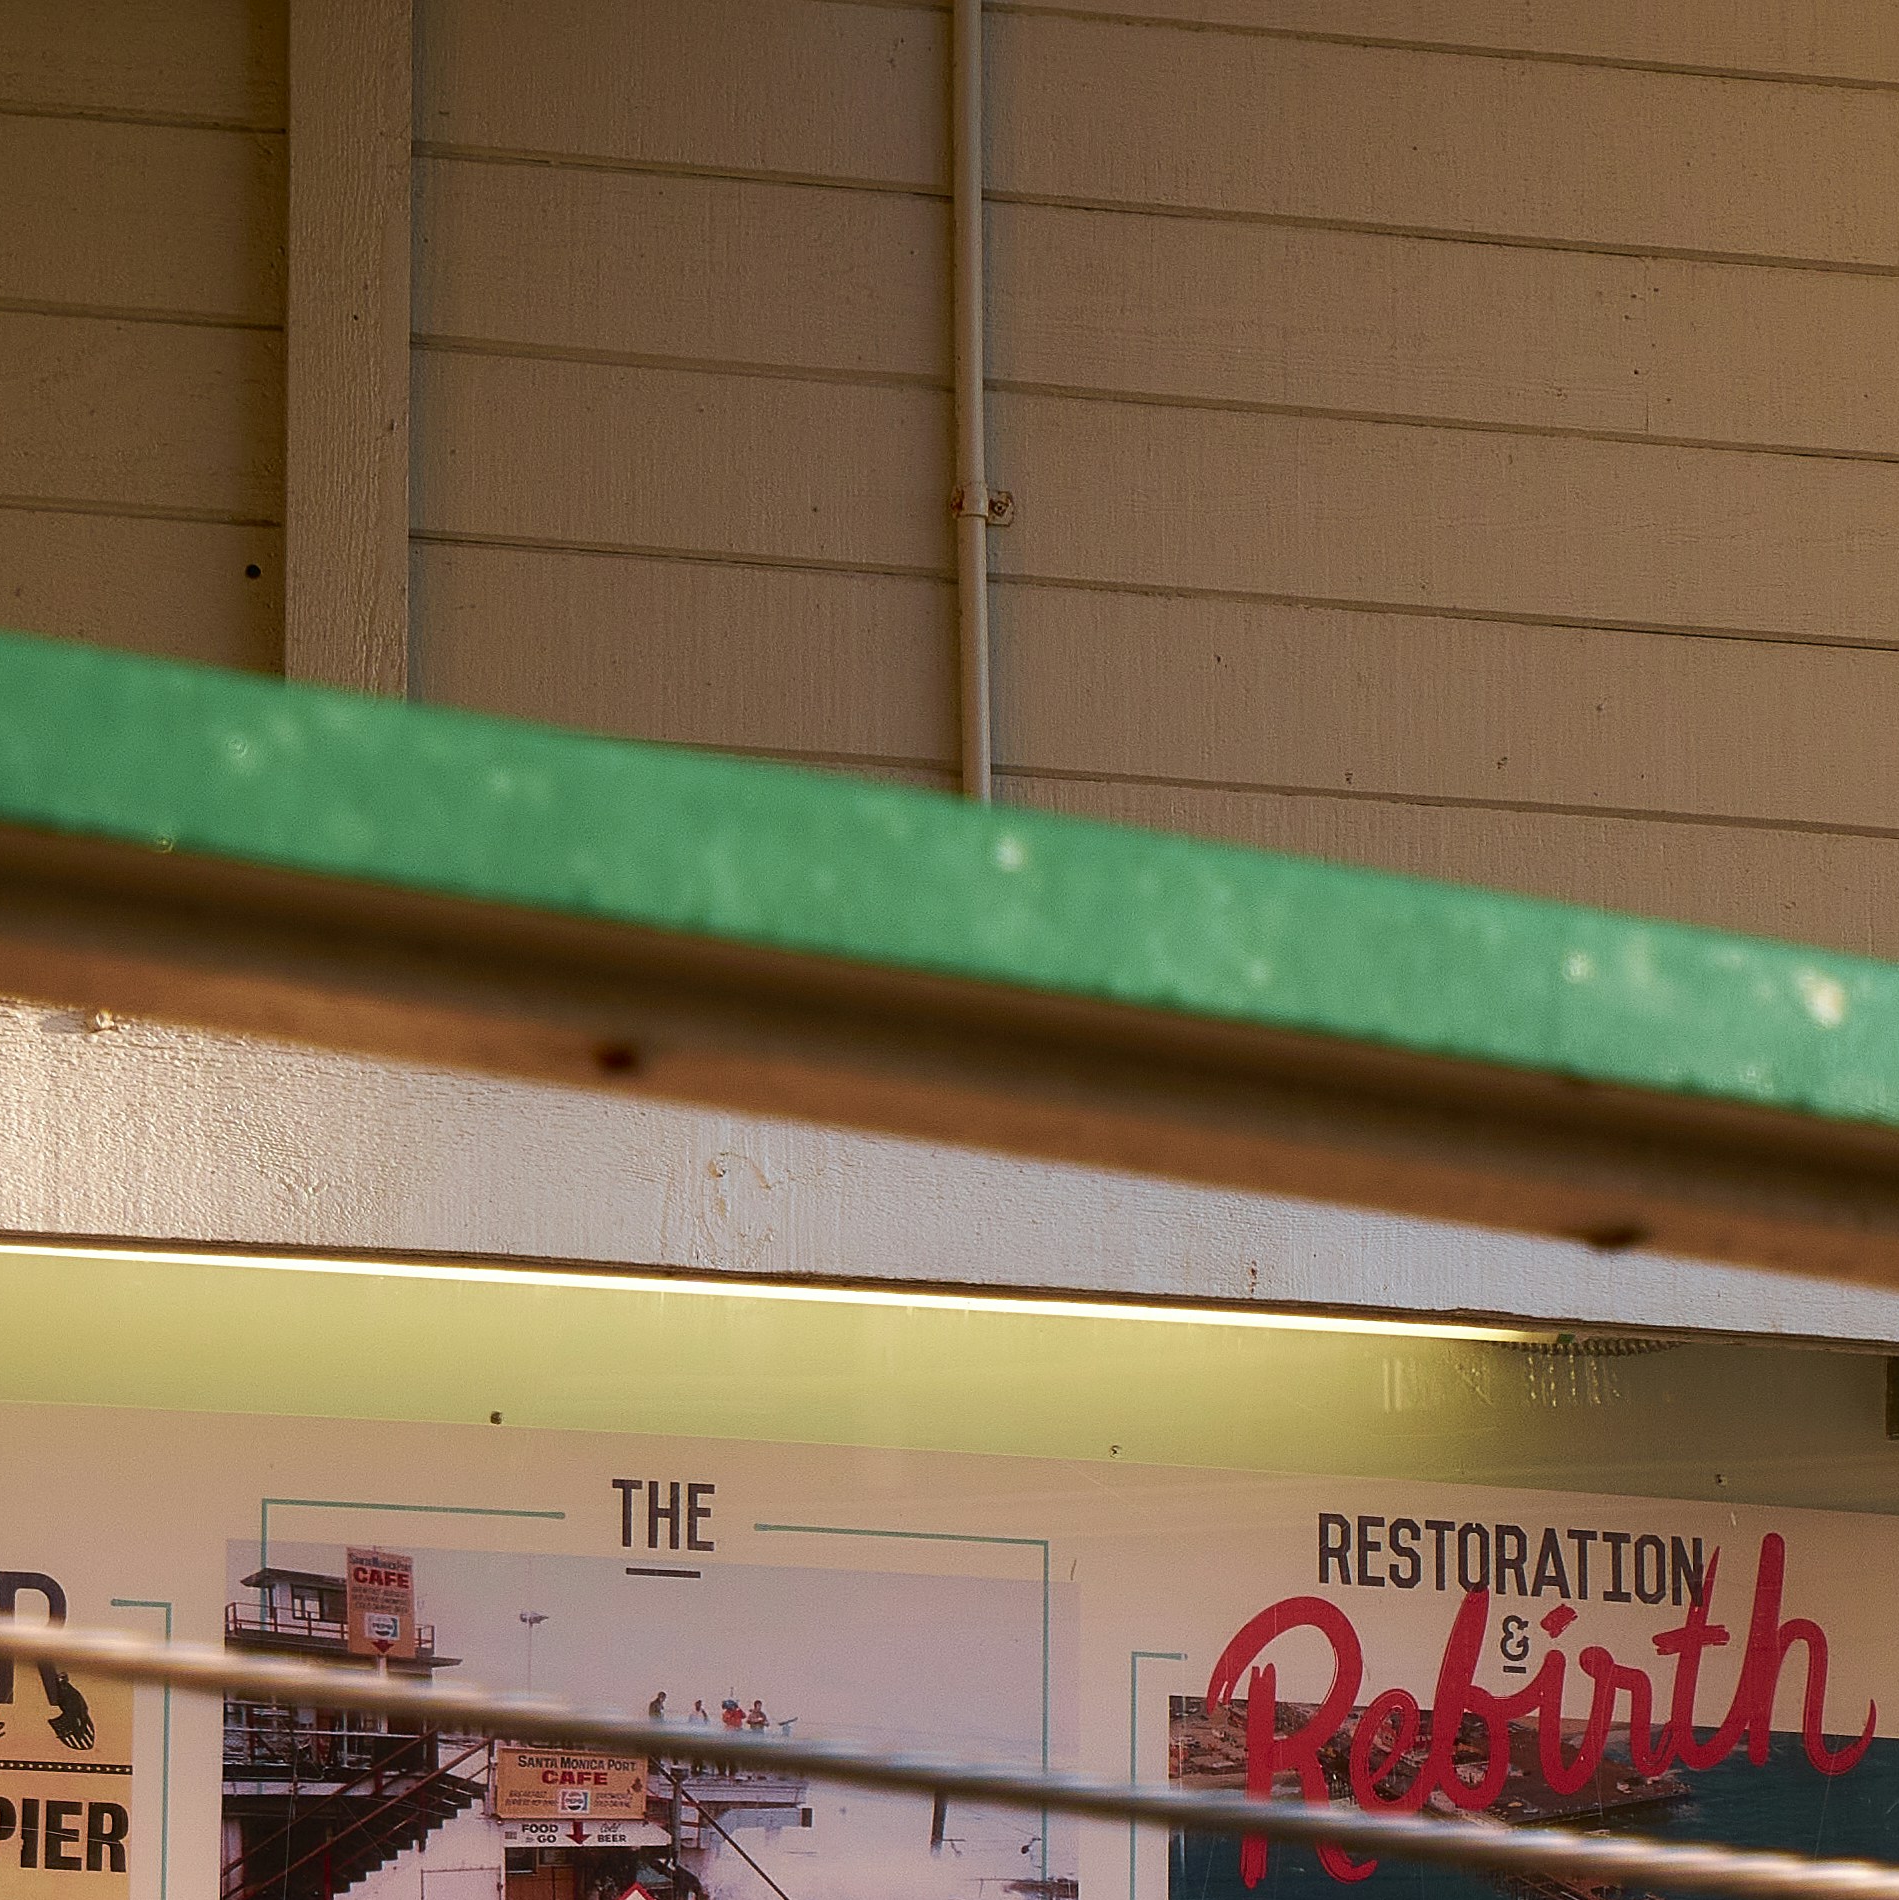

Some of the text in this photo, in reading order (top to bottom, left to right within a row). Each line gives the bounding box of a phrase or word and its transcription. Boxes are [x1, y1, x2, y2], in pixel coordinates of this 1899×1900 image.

[611, 1478, 716, 1552] THE
[1318, 1512, 1704, 1606] RESTORATION
[353, 1566, 410, 1590] CAFE
[1500, 1615, 1530, 1662] &
[1207, 1532, 1878, 1889] Rebirth
[518, 1754, 637, 1772] SANTA MONICA PORT
[541, 1769, 609, 1786] CAFE
[521, 1823, 559, 1834] FOOD
[536, 1834, 557, 1844] GO
[597, 1833, 628, 1843] BEER
